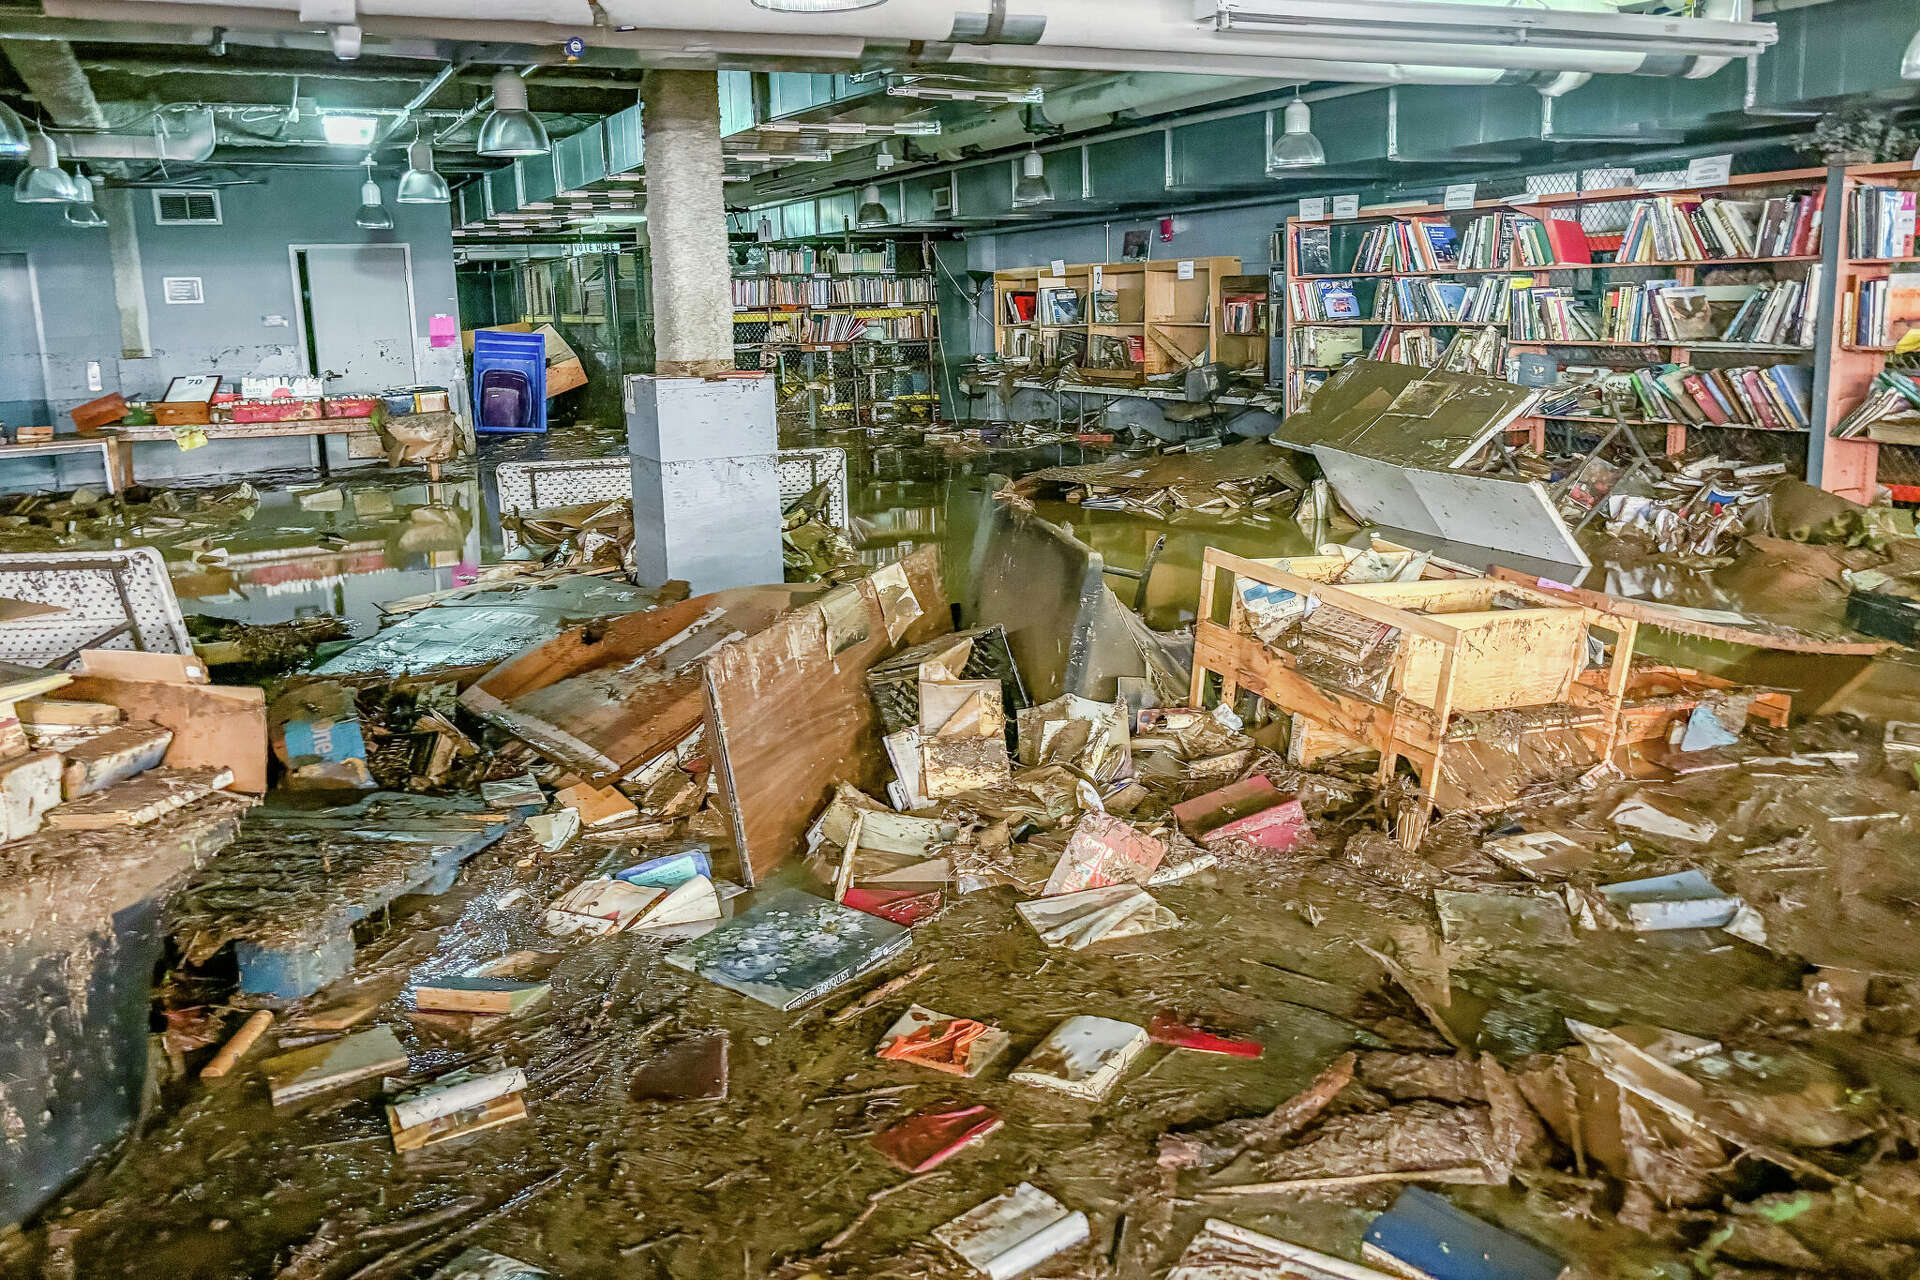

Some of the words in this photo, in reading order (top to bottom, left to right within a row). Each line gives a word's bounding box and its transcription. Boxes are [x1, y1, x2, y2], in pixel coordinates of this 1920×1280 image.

[574, 244, 593, 252] VOTE
[596, 244, 615, 252] HERE
[816, 969, 850, 996] BOUQUET
